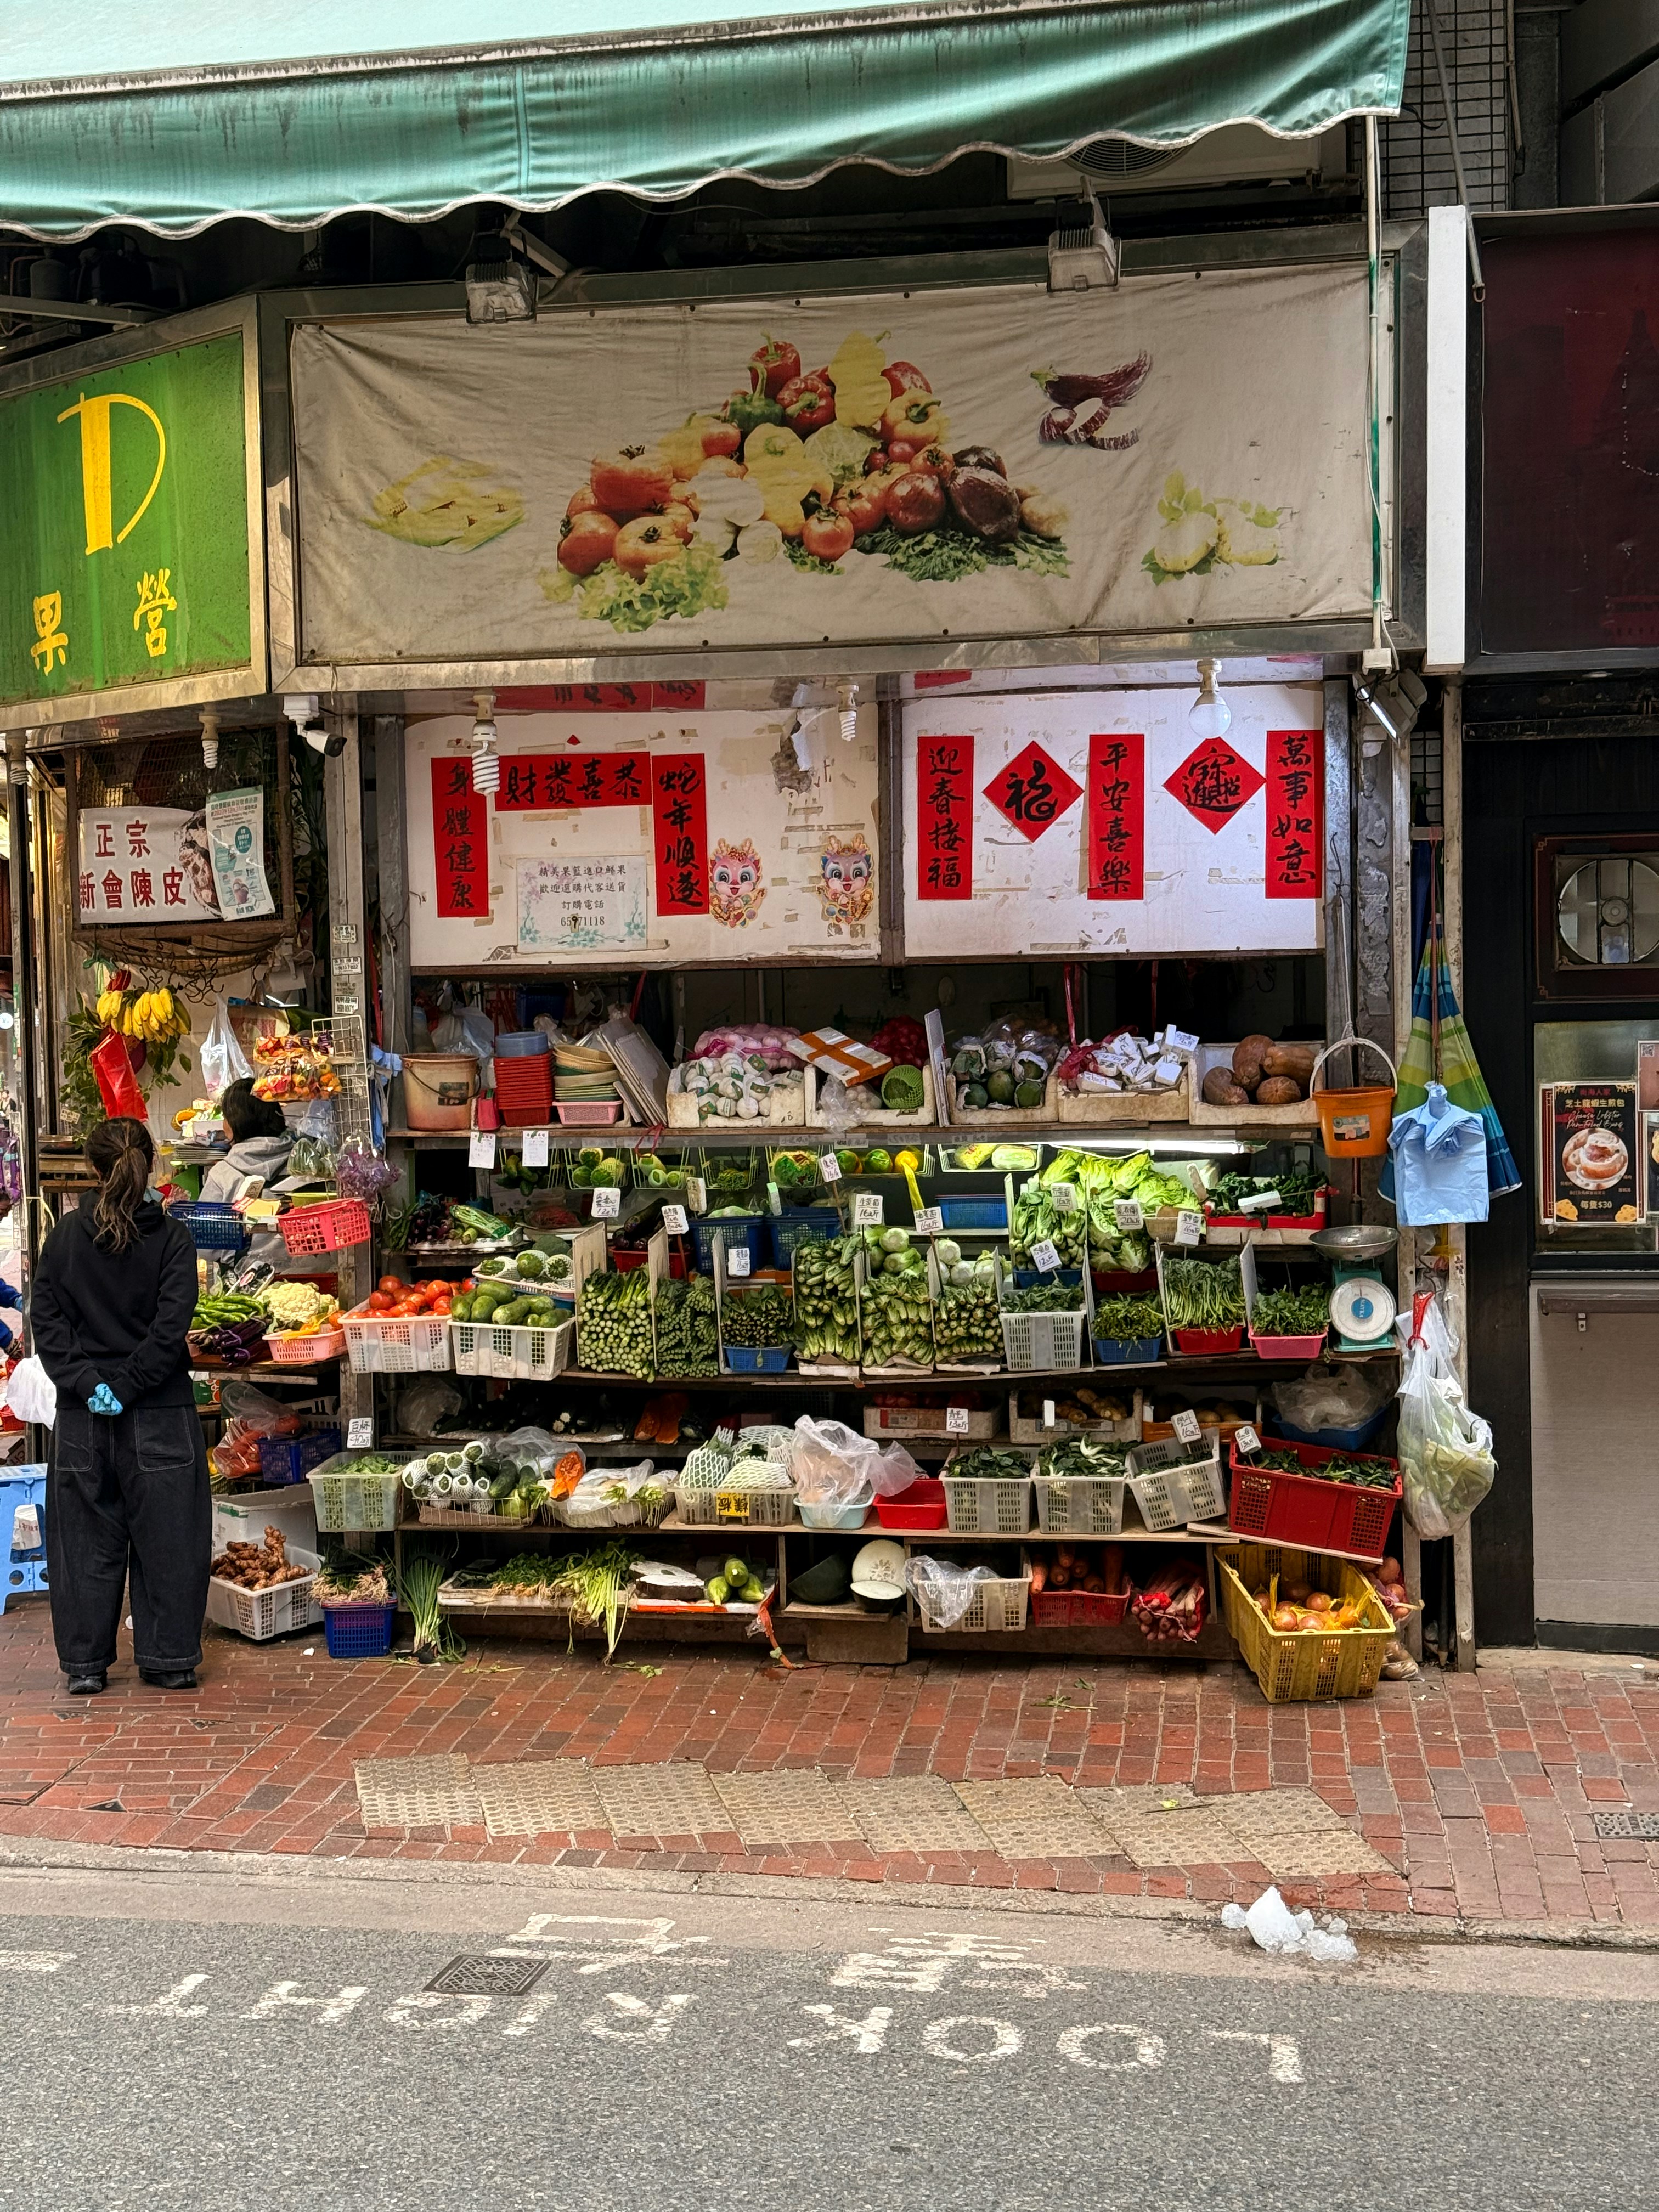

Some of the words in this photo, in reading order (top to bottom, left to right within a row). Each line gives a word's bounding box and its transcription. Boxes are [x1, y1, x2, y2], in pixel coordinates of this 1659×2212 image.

[926, 746, 966, 890] 迎春接福
[1003, 759, 1058, 822] 福
[1099, 742, 1133, 895] 平安喜樂
[1271, 735, 1316, 884] 萬事如意
[95, 820, 151, 858] 正宗
[441, 760, 477, 910] 身體健康
[659, 761, 704, 908] 蛇年順遂
[560, 915, 605, 929] 65971118
[561, 899, 605, 911] 訂購電話
[93, 1973, 699, 2042] RIGHT
[786, 2004, 1306, 2084] LOOK
